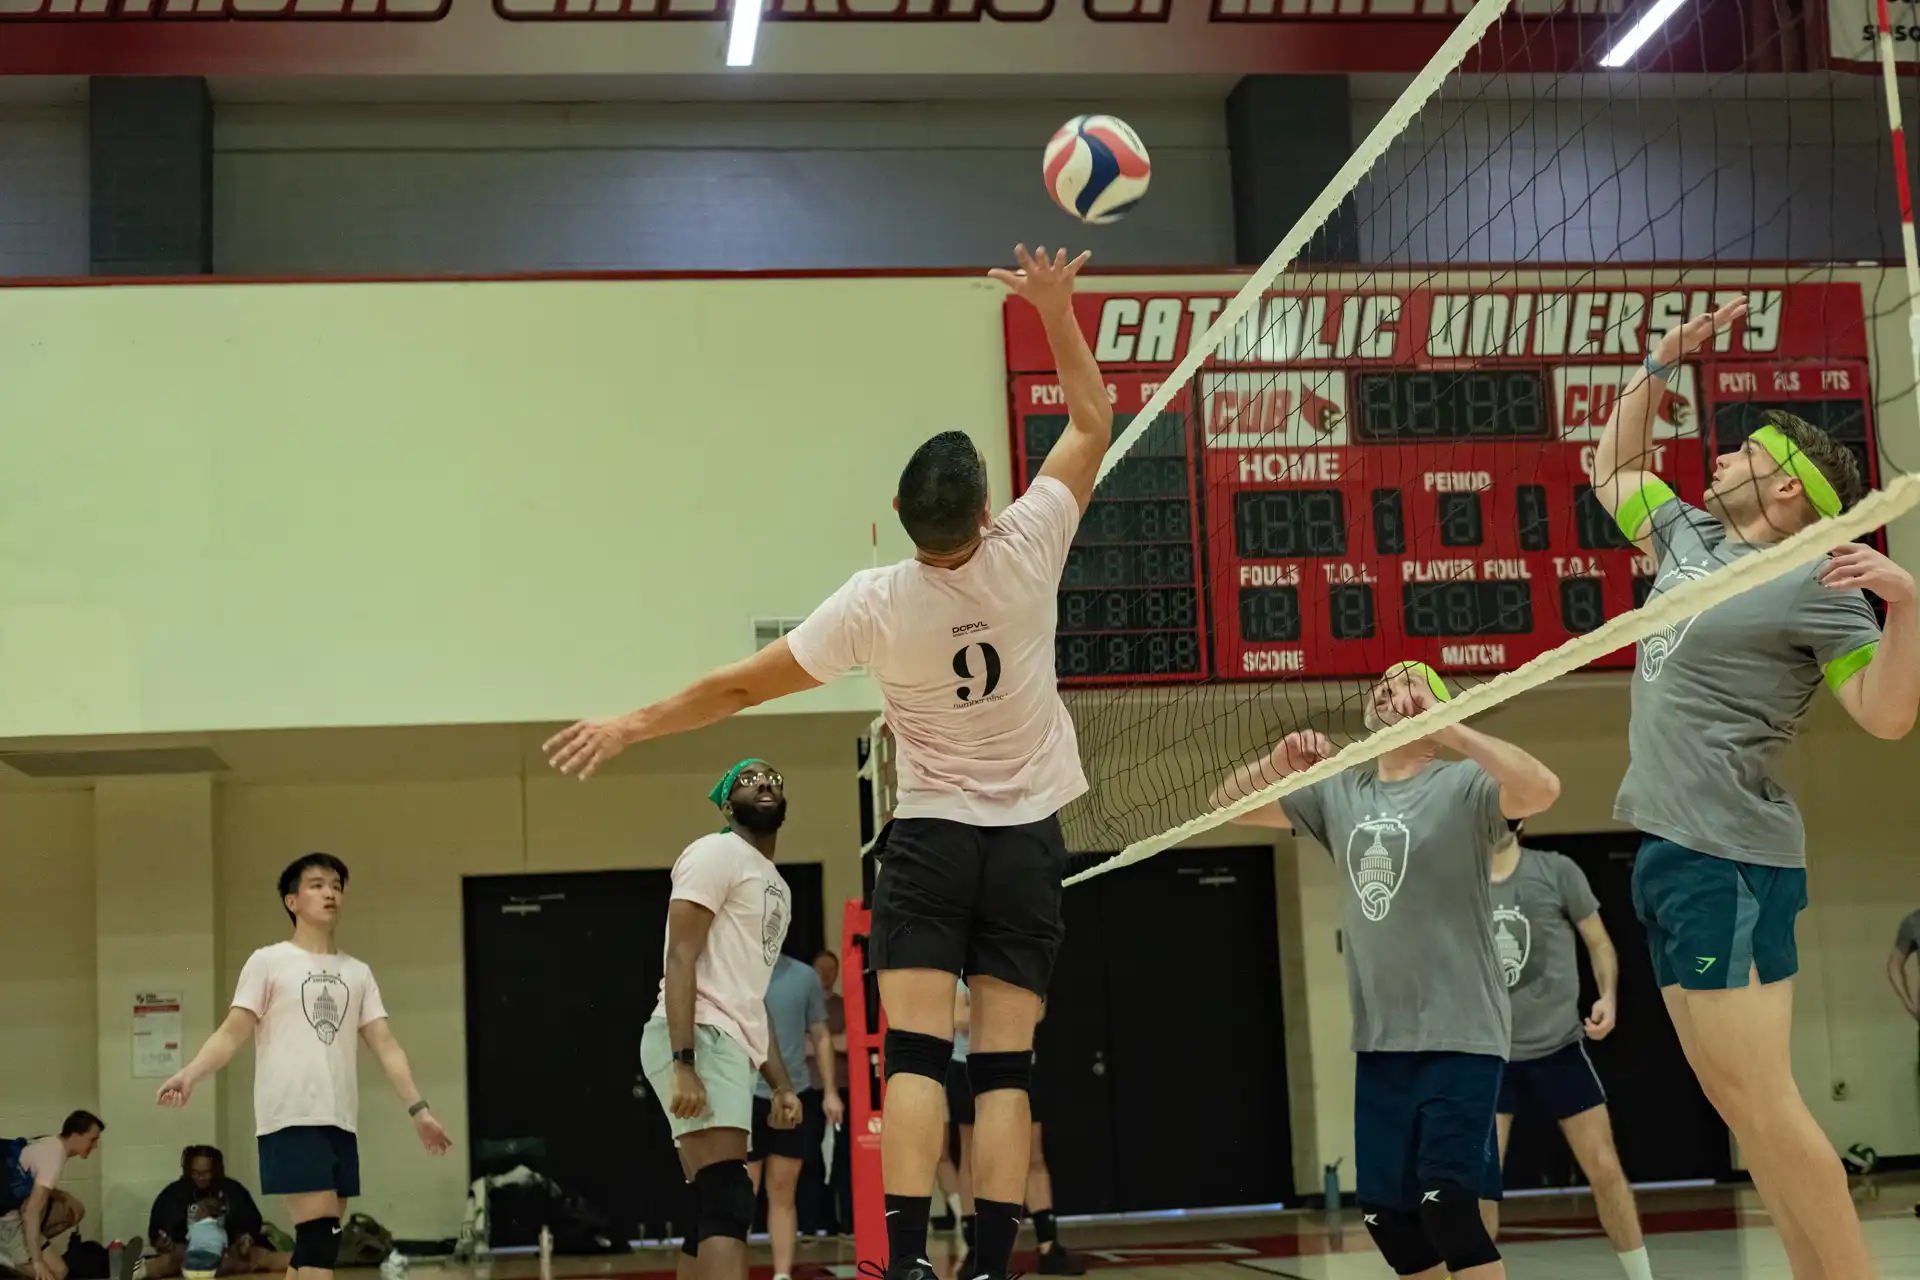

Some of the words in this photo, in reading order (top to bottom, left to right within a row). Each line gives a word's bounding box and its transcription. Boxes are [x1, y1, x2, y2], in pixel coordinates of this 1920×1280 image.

[1821, 370, 1850, 391] PTS
[1239, 453, 1341, 483] HOME
[1424, 470, 1491, 492] PERIOD
[1240, 564, 1299, 586] FOULS
[1402, 559, 1477, 580] PLAYER
[1483, 558, 1532, 579] FOUL
[952, 621, 987, 634] DCPVL
[1243, 650, 1304, 672] SCORE
[1441, 644, 1505, 665] MATCH
[952, 642, 1001, 702] 9
